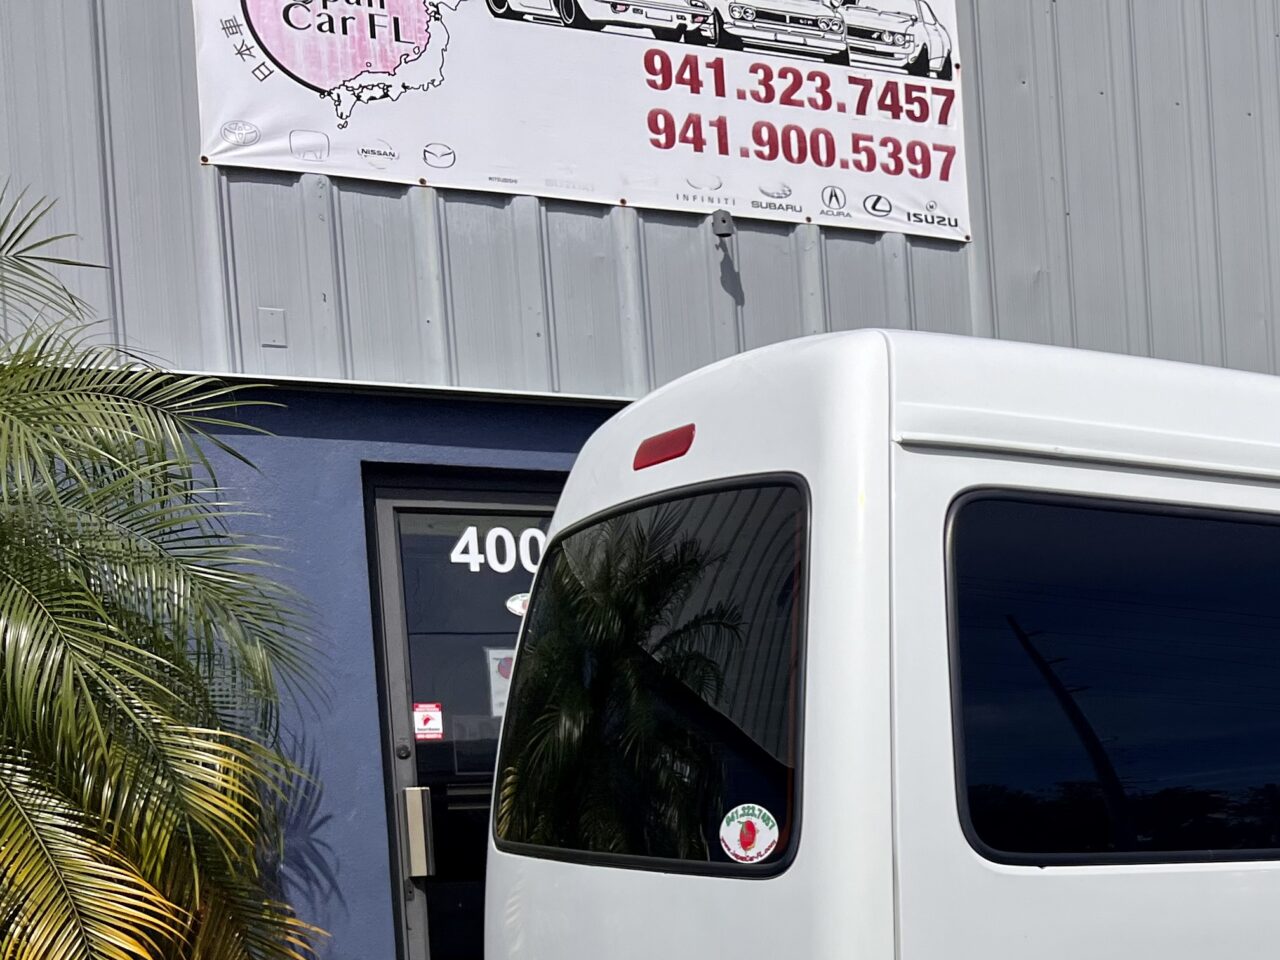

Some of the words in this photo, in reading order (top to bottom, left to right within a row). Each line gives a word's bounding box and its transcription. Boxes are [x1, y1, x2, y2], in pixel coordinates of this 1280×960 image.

[282, 3, 356, 36] Car
[368, 13, 416, 45] FL
[643, 48, 956, 126] 941.323.7457
[361, 148, 396, 158] NISSAN
[647, 107, 957, 182] 941.900.5397
[676, 193, 736, 206] INFINITI
[751, 200, 803, 213] SUBARU
[819, 209, 852, 219] ACURA
[907, 211, 959, 228] ISUZU
[450, 526, 546, 574] 400
